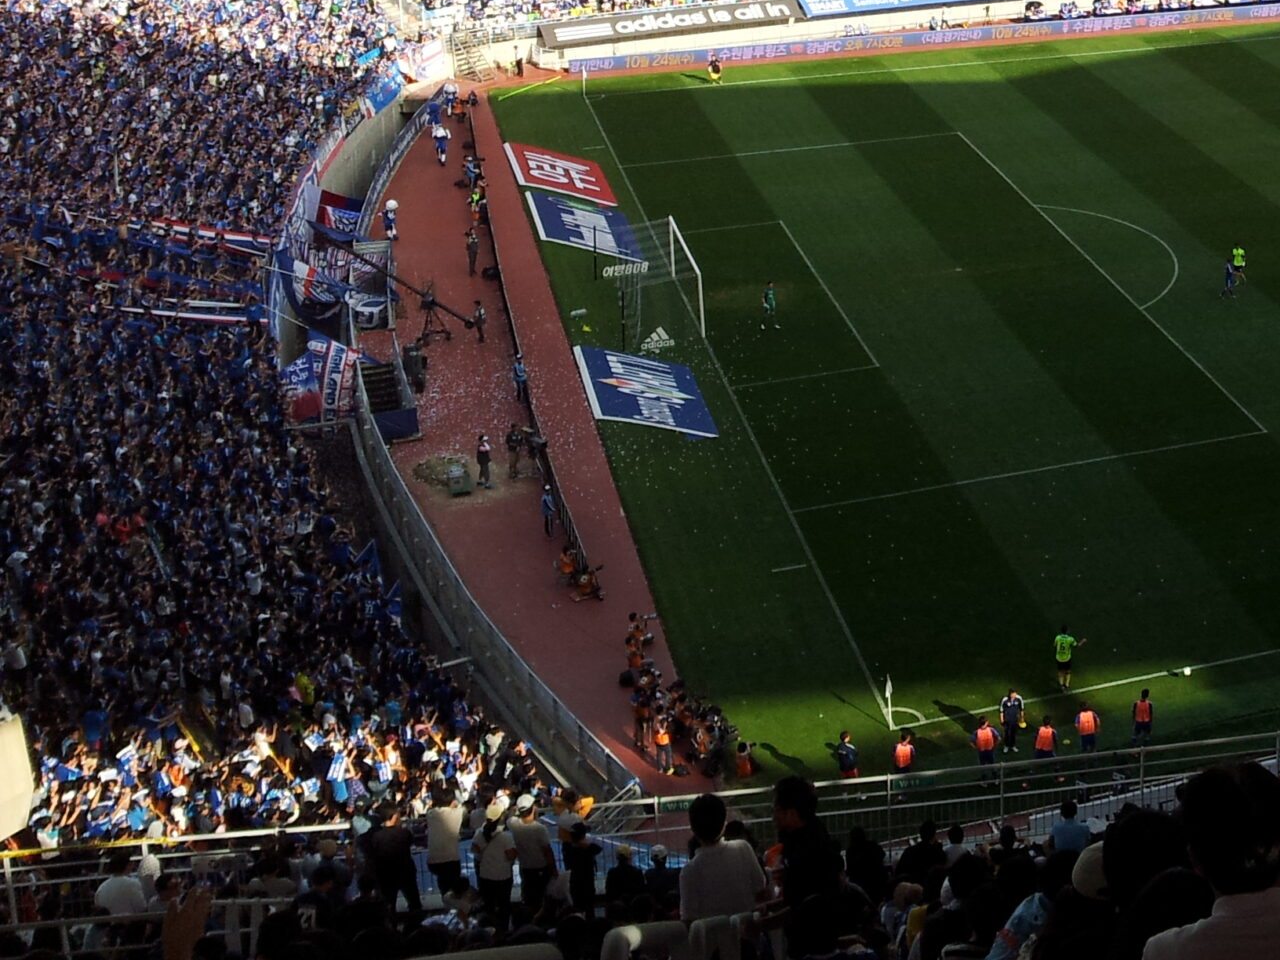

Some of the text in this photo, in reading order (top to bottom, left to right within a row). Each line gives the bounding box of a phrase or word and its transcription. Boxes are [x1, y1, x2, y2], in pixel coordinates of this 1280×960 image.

[615, 2, 791, 34] adidas is all in
[641, 339, 675, 350] adidas
